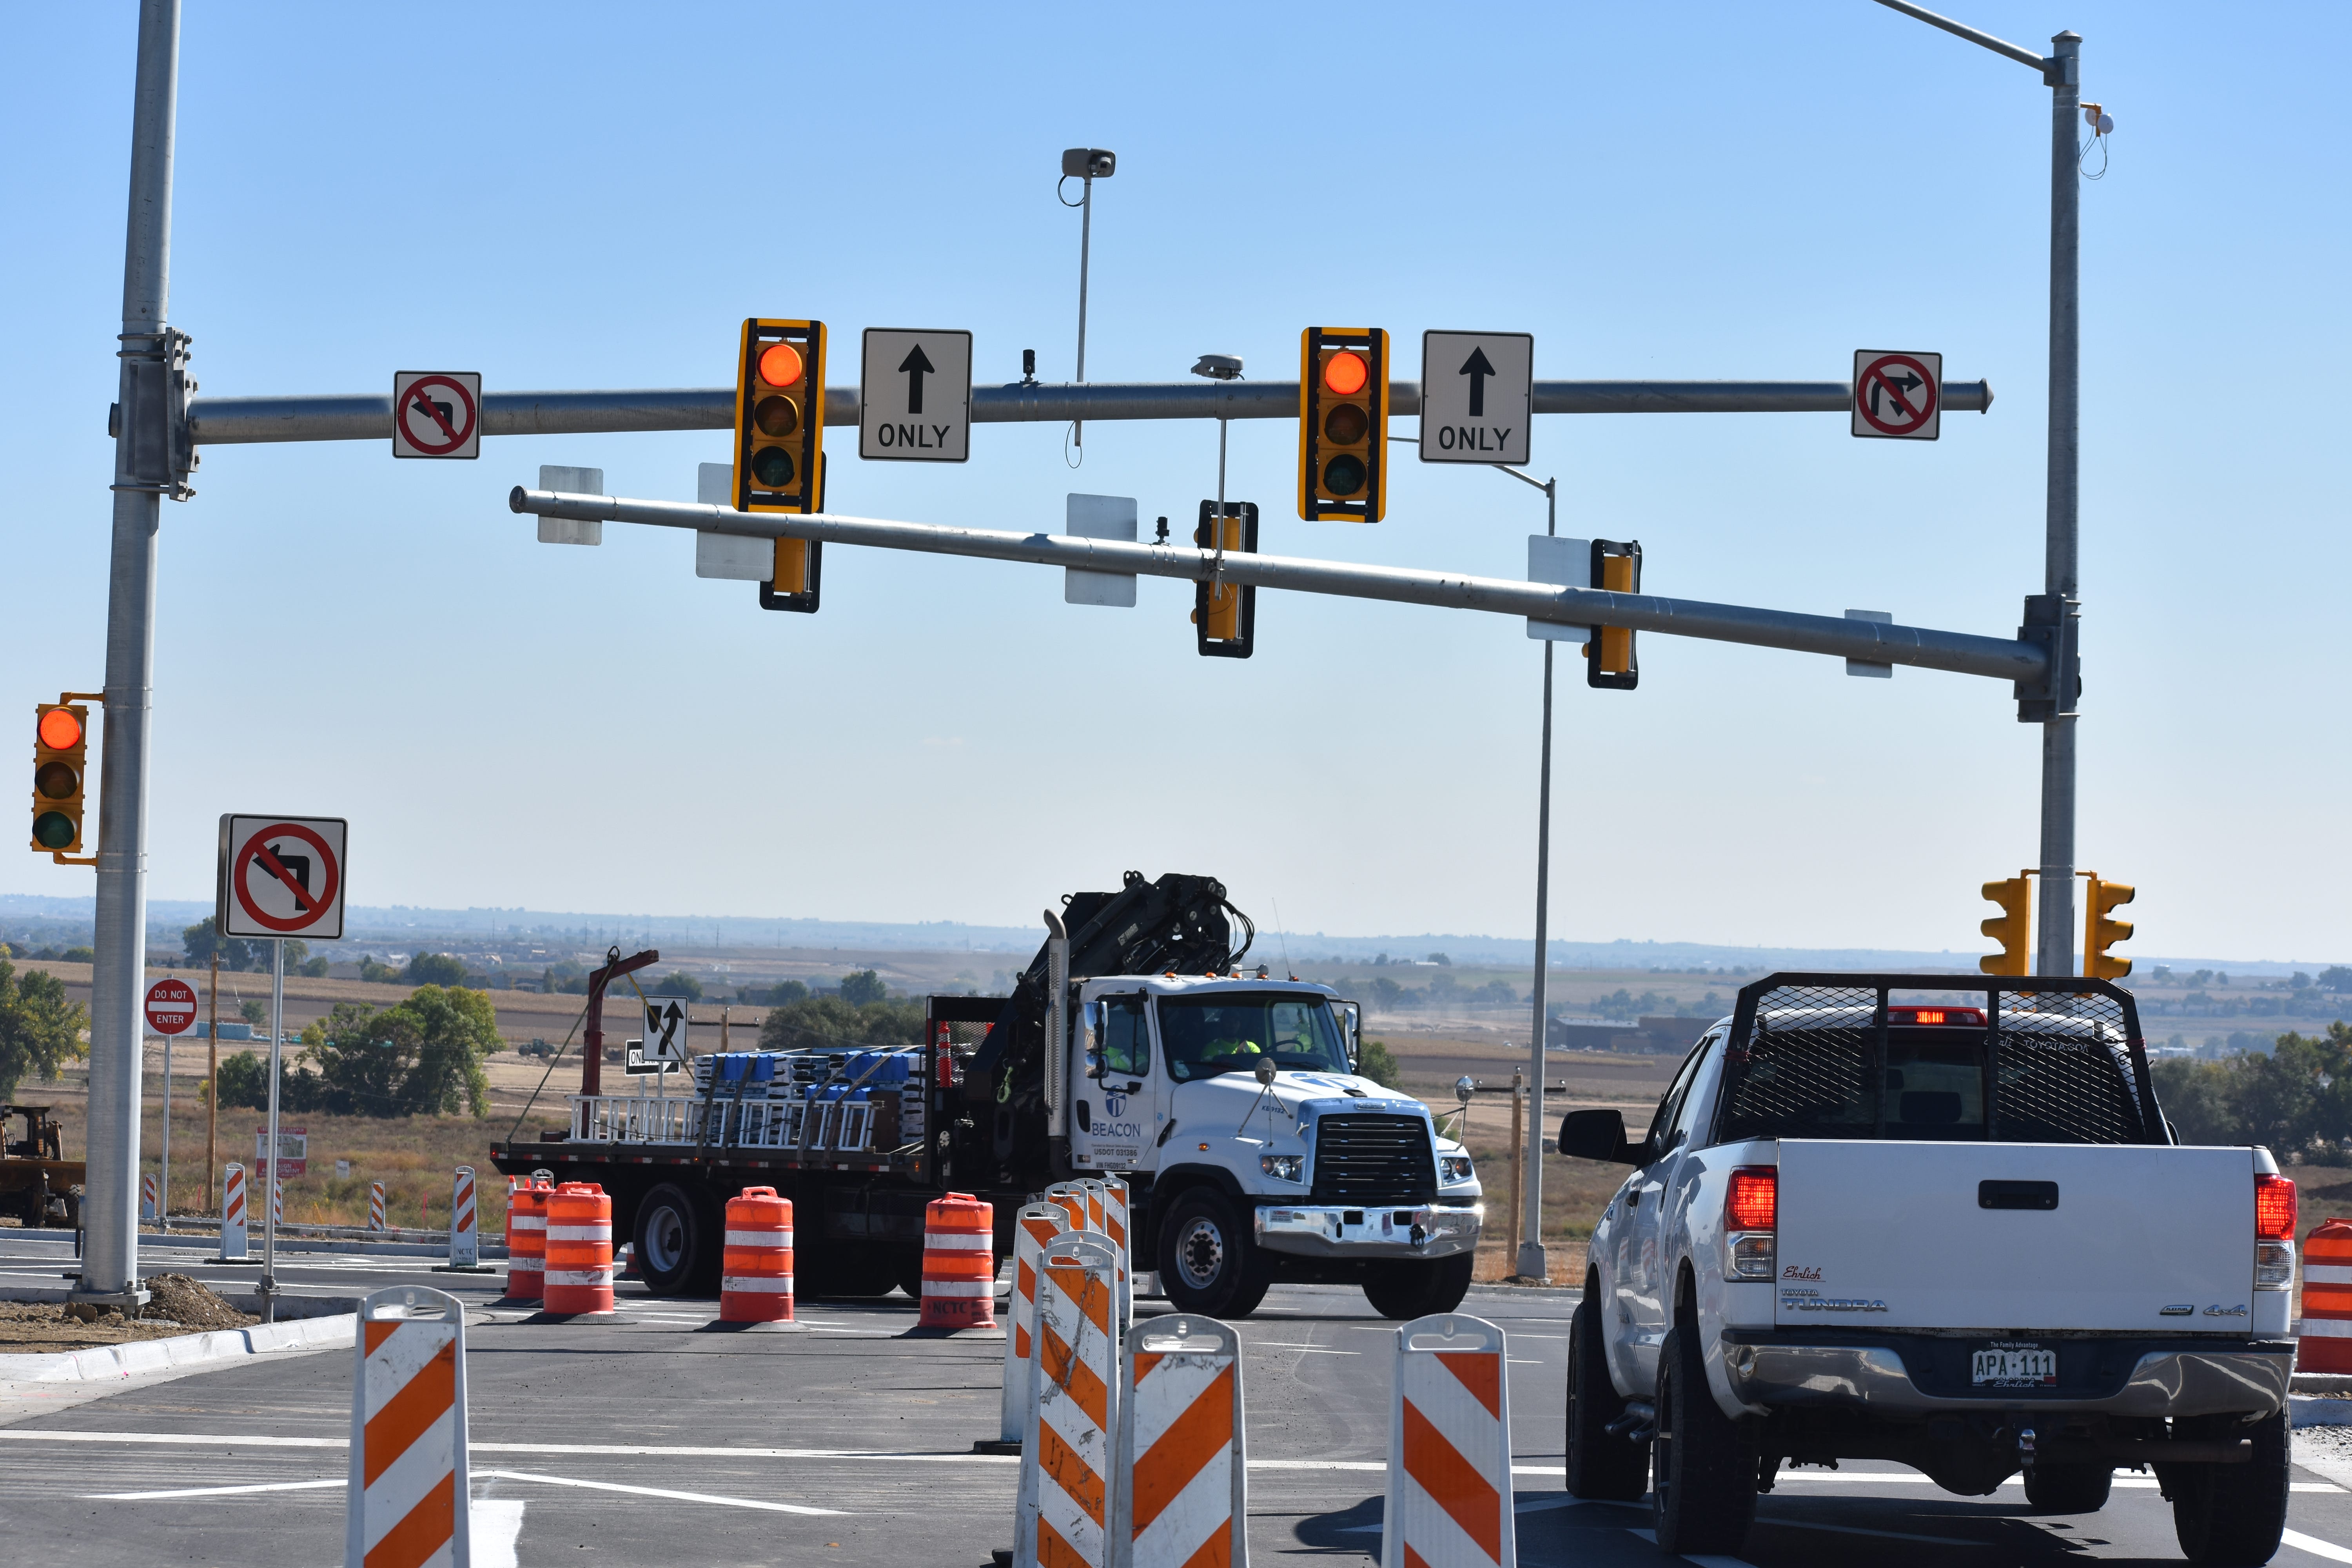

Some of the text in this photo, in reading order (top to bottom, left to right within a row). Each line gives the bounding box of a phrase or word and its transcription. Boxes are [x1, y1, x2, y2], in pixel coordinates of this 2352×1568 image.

[878, 423, 950, 448] ONLY
[1439, 426, 1511, 451] ONLY
[155, 990, 187, 999] DO NOT
[157, 1015, 184, 1024] ENTER
[631, 1051, 645, 1063] ON
[1092, 1123, 1140, 1137] BEACON
[1783, 1266, 1821, 1279] Ehrlich
[933, 1302, 967, 1313] NCTC
[1781, 1298, 1888, 1312] TUNDRA
[2203, 1305, 2248, 1316] 4x4
[1993, 1379, 2035, 1388] Ehrlich
